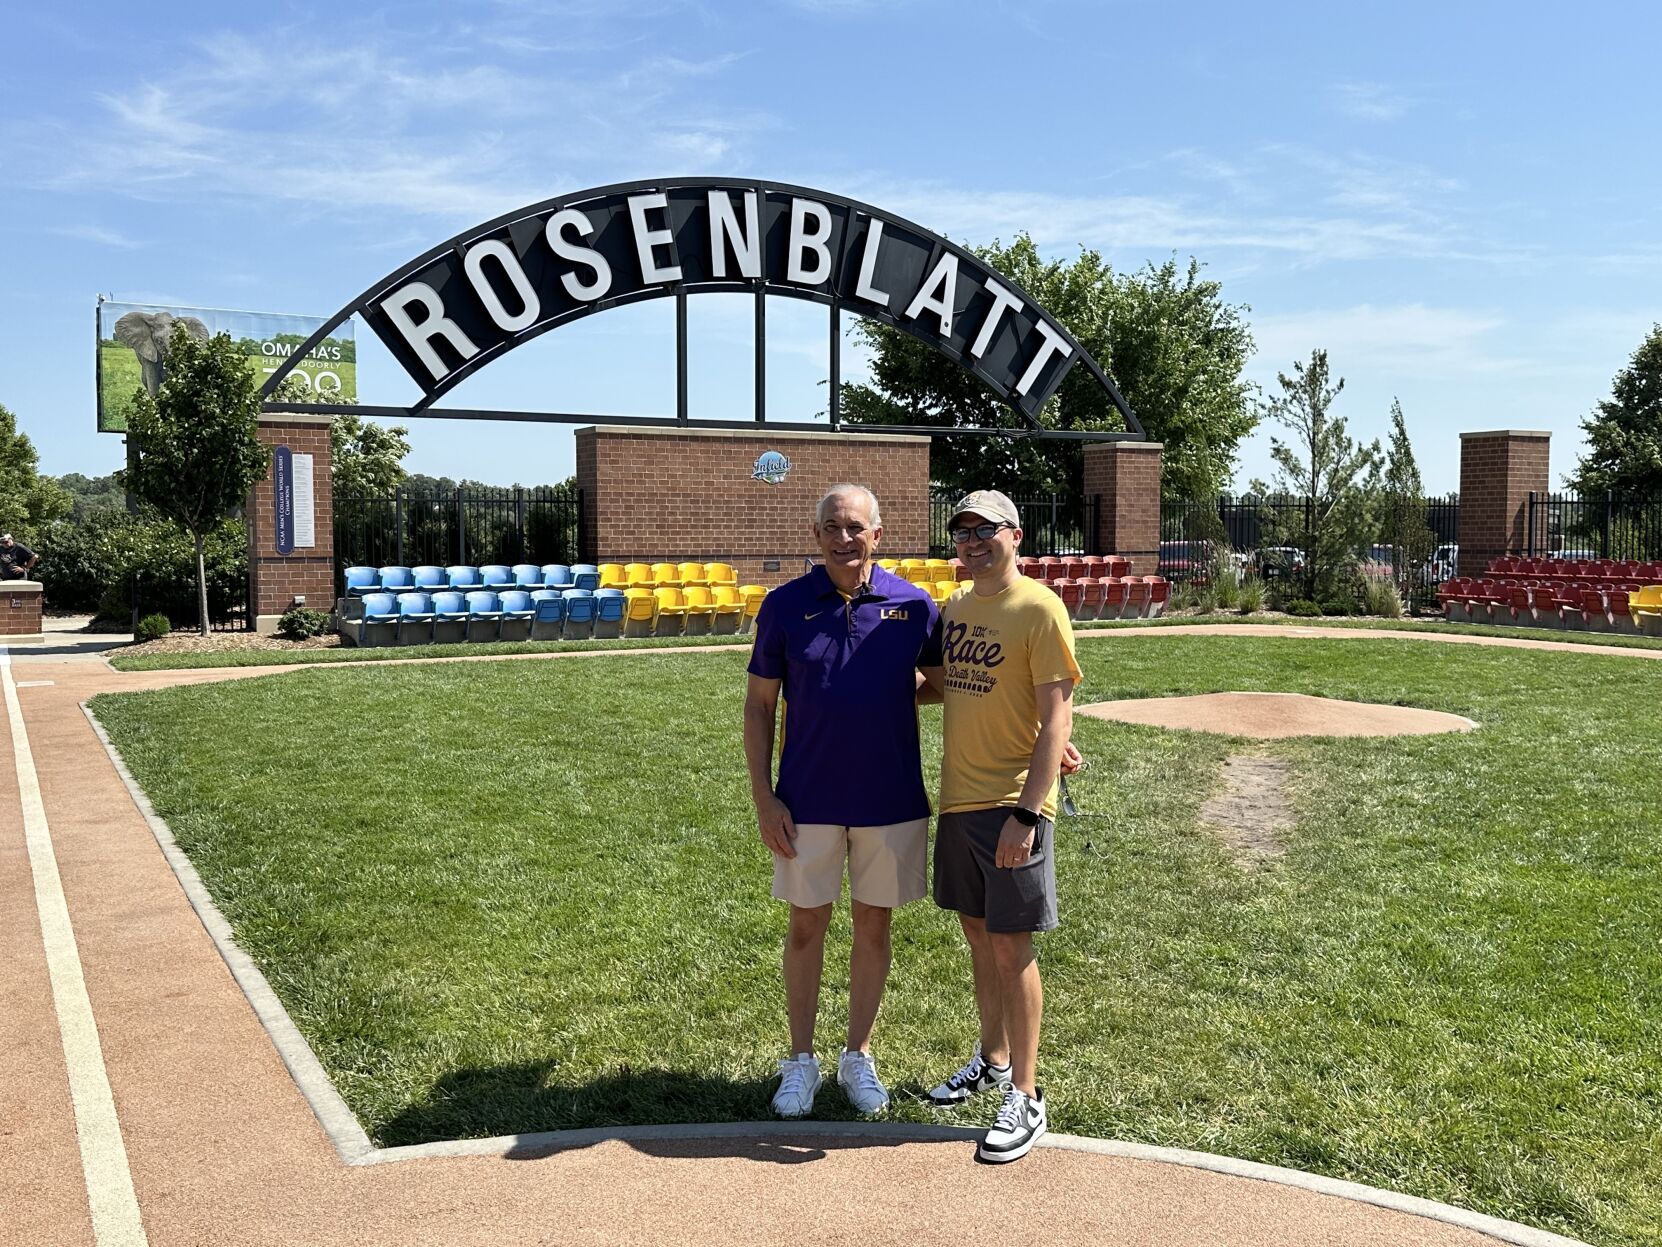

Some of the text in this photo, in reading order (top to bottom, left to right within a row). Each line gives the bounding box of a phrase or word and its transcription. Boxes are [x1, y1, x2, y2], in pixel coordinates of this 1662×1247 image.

[380, 190, 1073, 397] ROSENBLATT
[262, 358, 341, 369] HEN DOORLY
[753, 457, 791, 476] Infield
[880, 608, 908, 620] LSU
[971, 625, 988, 638] 10K
[943, 620, 1005, 668] Race
[949, 665, 968, 679] Death
[971, 669, 998, 692] Valley
